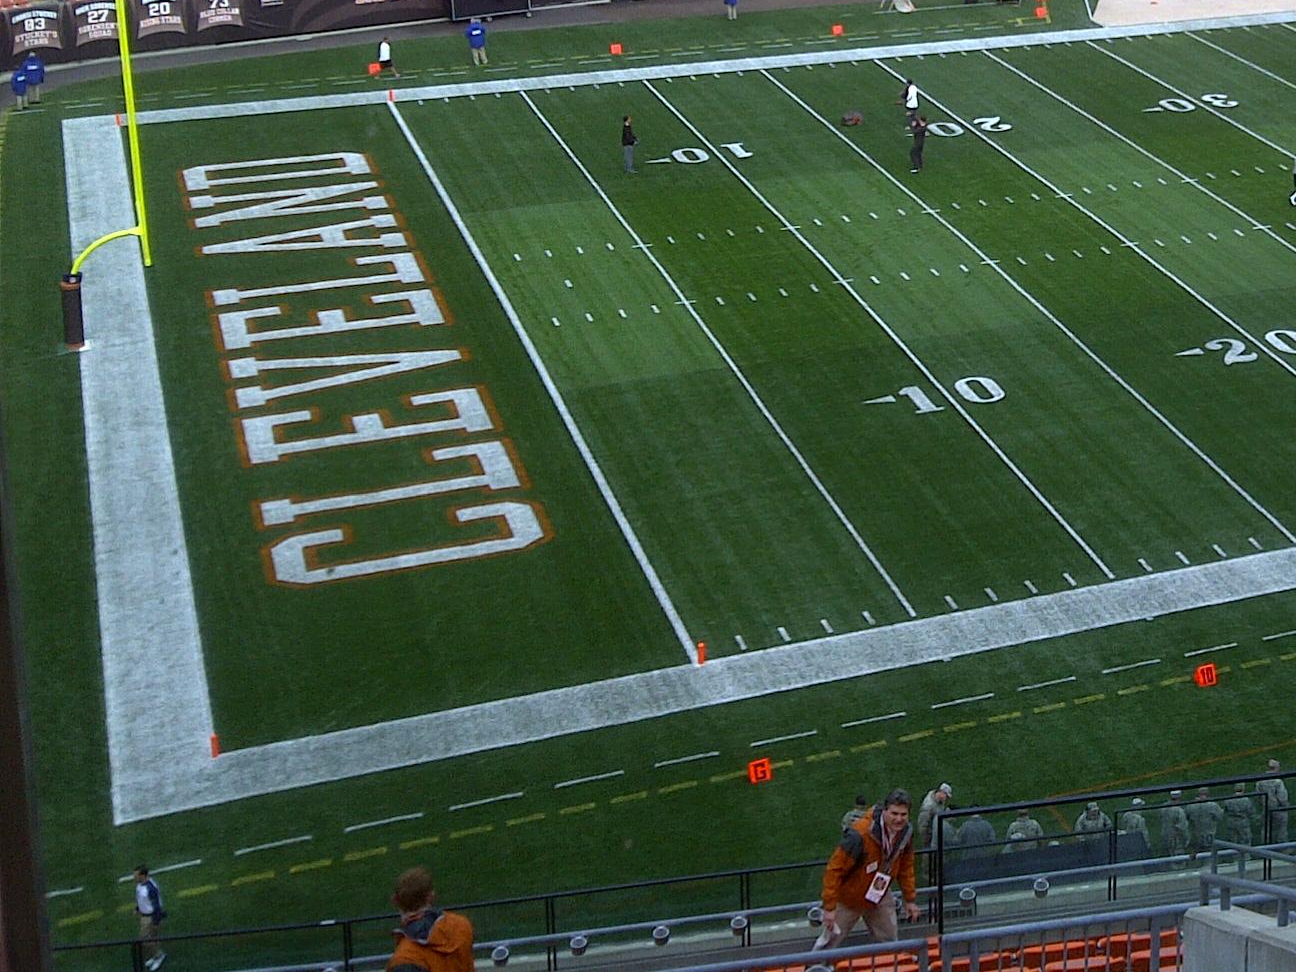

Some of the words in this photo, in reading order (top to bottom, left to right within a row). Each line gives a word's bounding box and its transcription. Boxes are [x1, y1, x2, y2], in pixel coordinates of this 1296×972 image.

[87, 9, 109, 23] 27
[149, 1, 171, 17] 20
[1158, 93, 1240, 115] 30
[925, 116, 1012, 137] 20
[671, 142, 754, 164] 10
[181, 151, 550, 585] CLEVELAND
[898, 376, 1006, 414] 10
[754, 761, 768, 780] G
